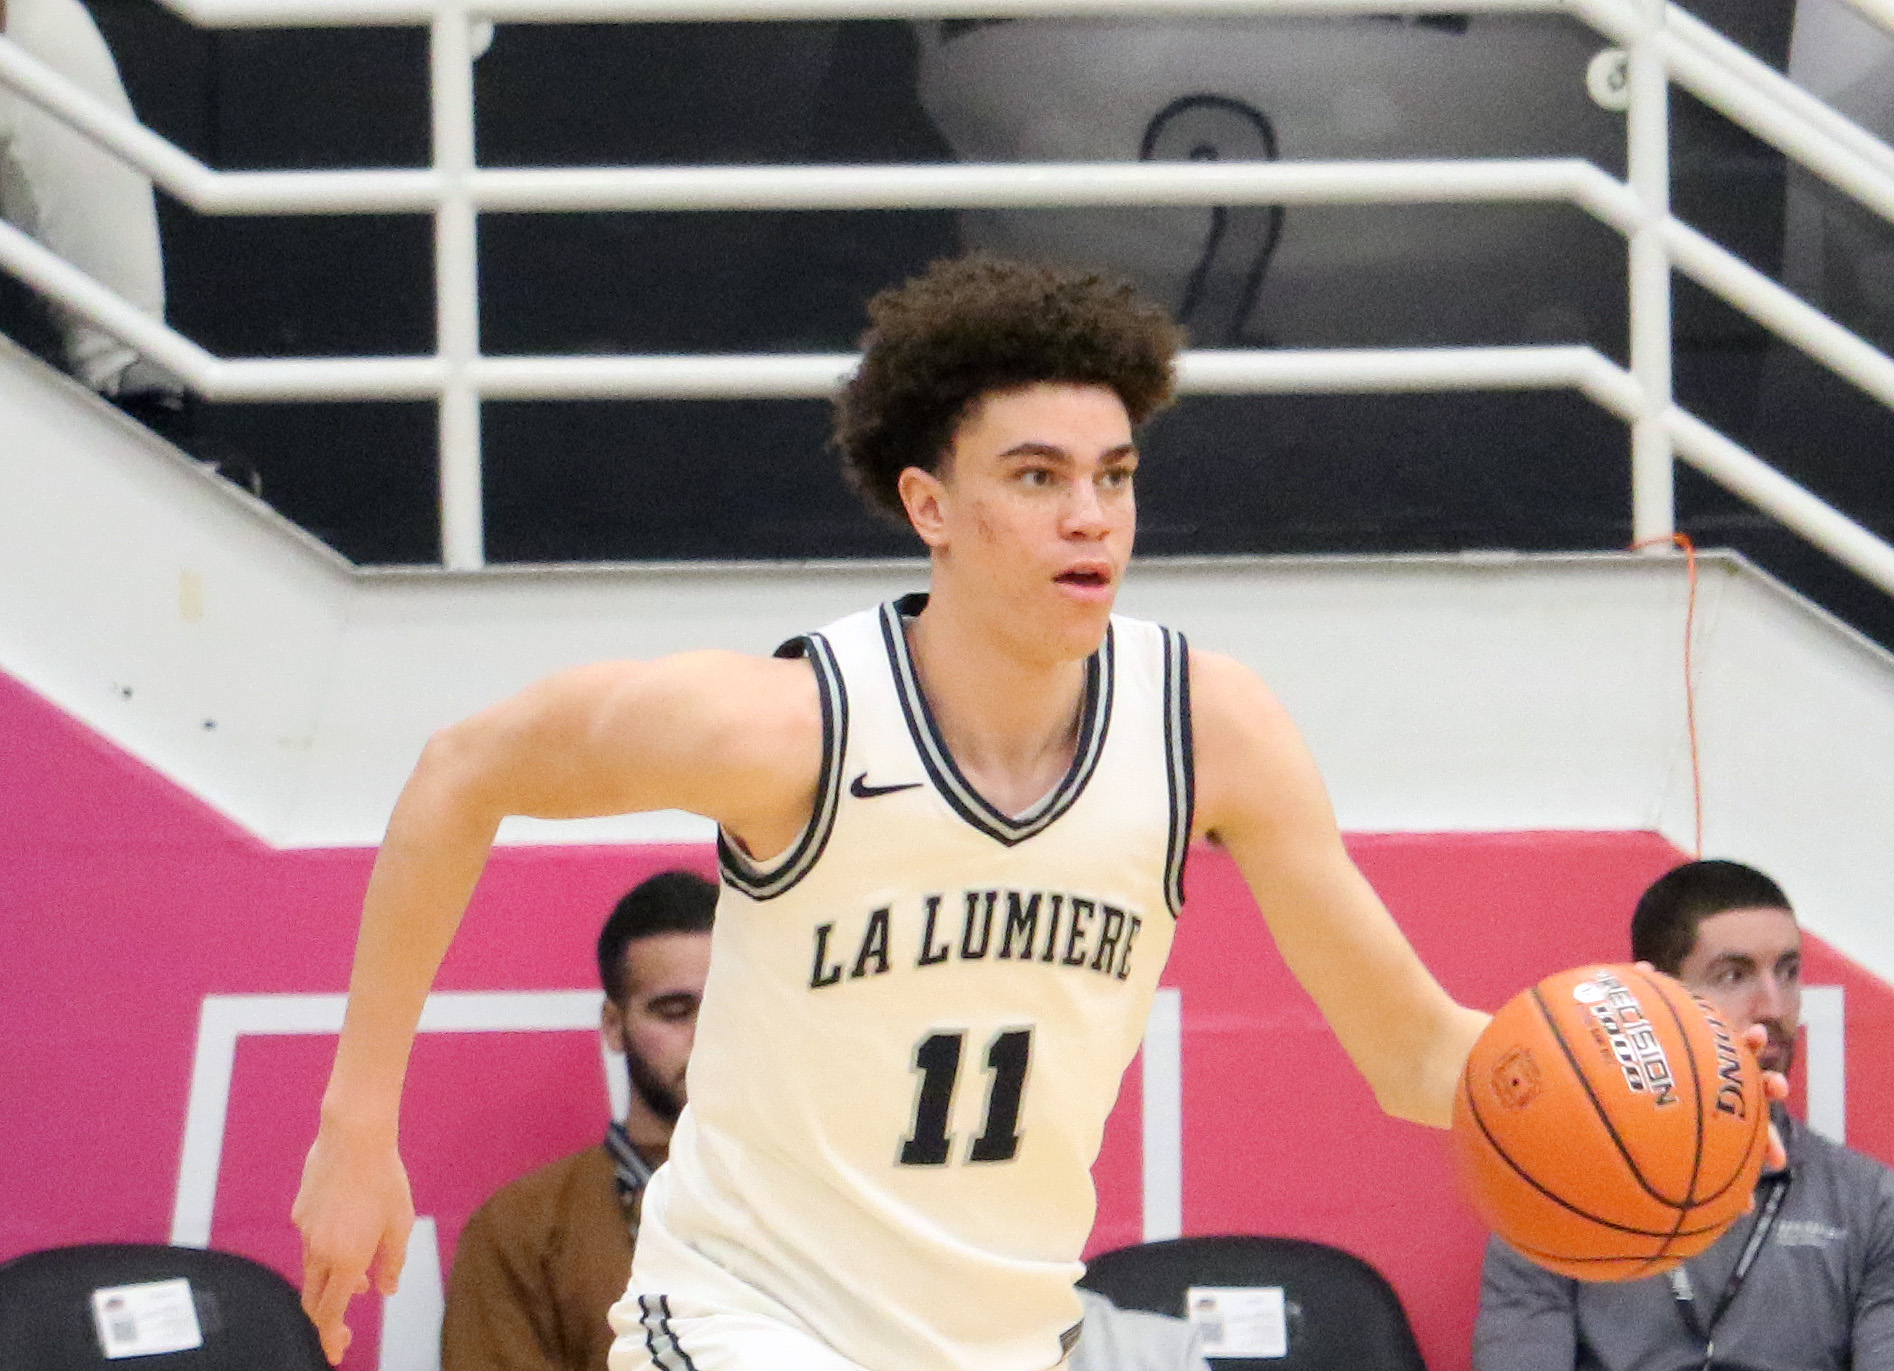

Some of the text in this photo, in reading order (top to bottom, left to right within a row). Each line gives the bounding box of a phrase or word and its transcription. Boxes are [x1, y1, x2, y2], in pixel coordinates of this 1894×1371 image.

[810, 890, 1142, 988] LA LUMIERE
[897, 1027, 1035, 1166] 11
